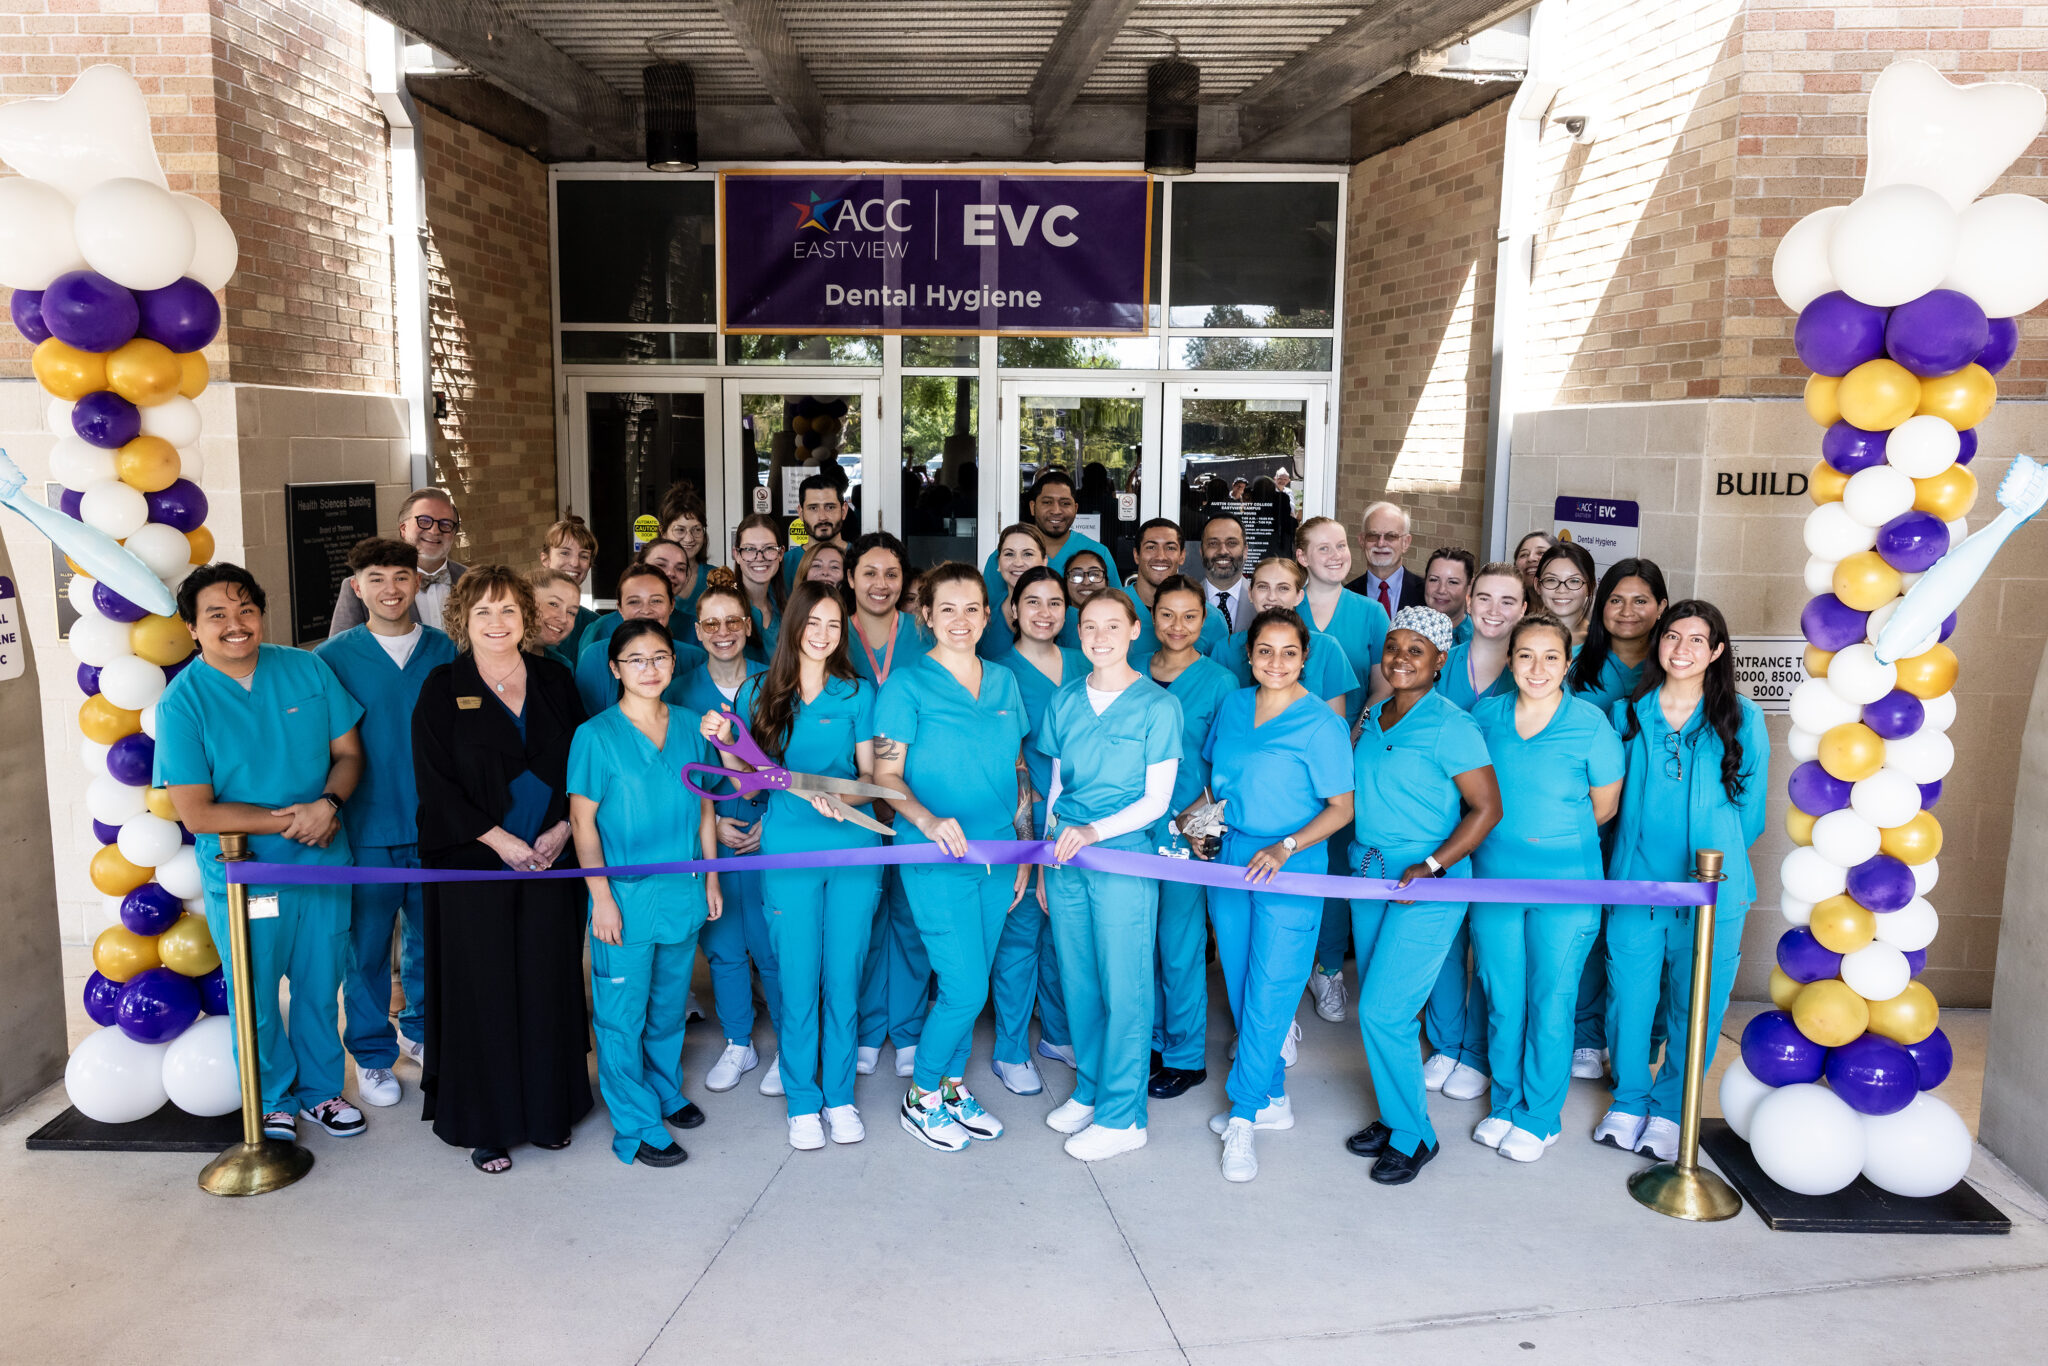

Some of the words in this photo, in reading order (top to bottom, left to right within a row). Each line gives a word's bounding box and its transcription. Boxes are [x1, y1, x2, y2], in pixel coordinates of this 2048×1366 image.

[833, 199, 912, 232] ACC
[963, 204, 1080, 247] EVC
[793, 241, 909, 259] EASTVIEW
[825, 284, 916, 306] Dental
[926, 284, 1042, 311] Hygiene
[297, 499, 318, 511] Health
[319, 498, 347, 510] Sciences
[348, 496, 371, 508] Building
[1581, 503, 1592, 512] ACC
[1599, 505, 1616, 518] EVC
[1577, 535, 1594, 544] Dental
[1595, 537, 1617, 547] Hygiene
[1753, 685, 1784, 696] 9000
